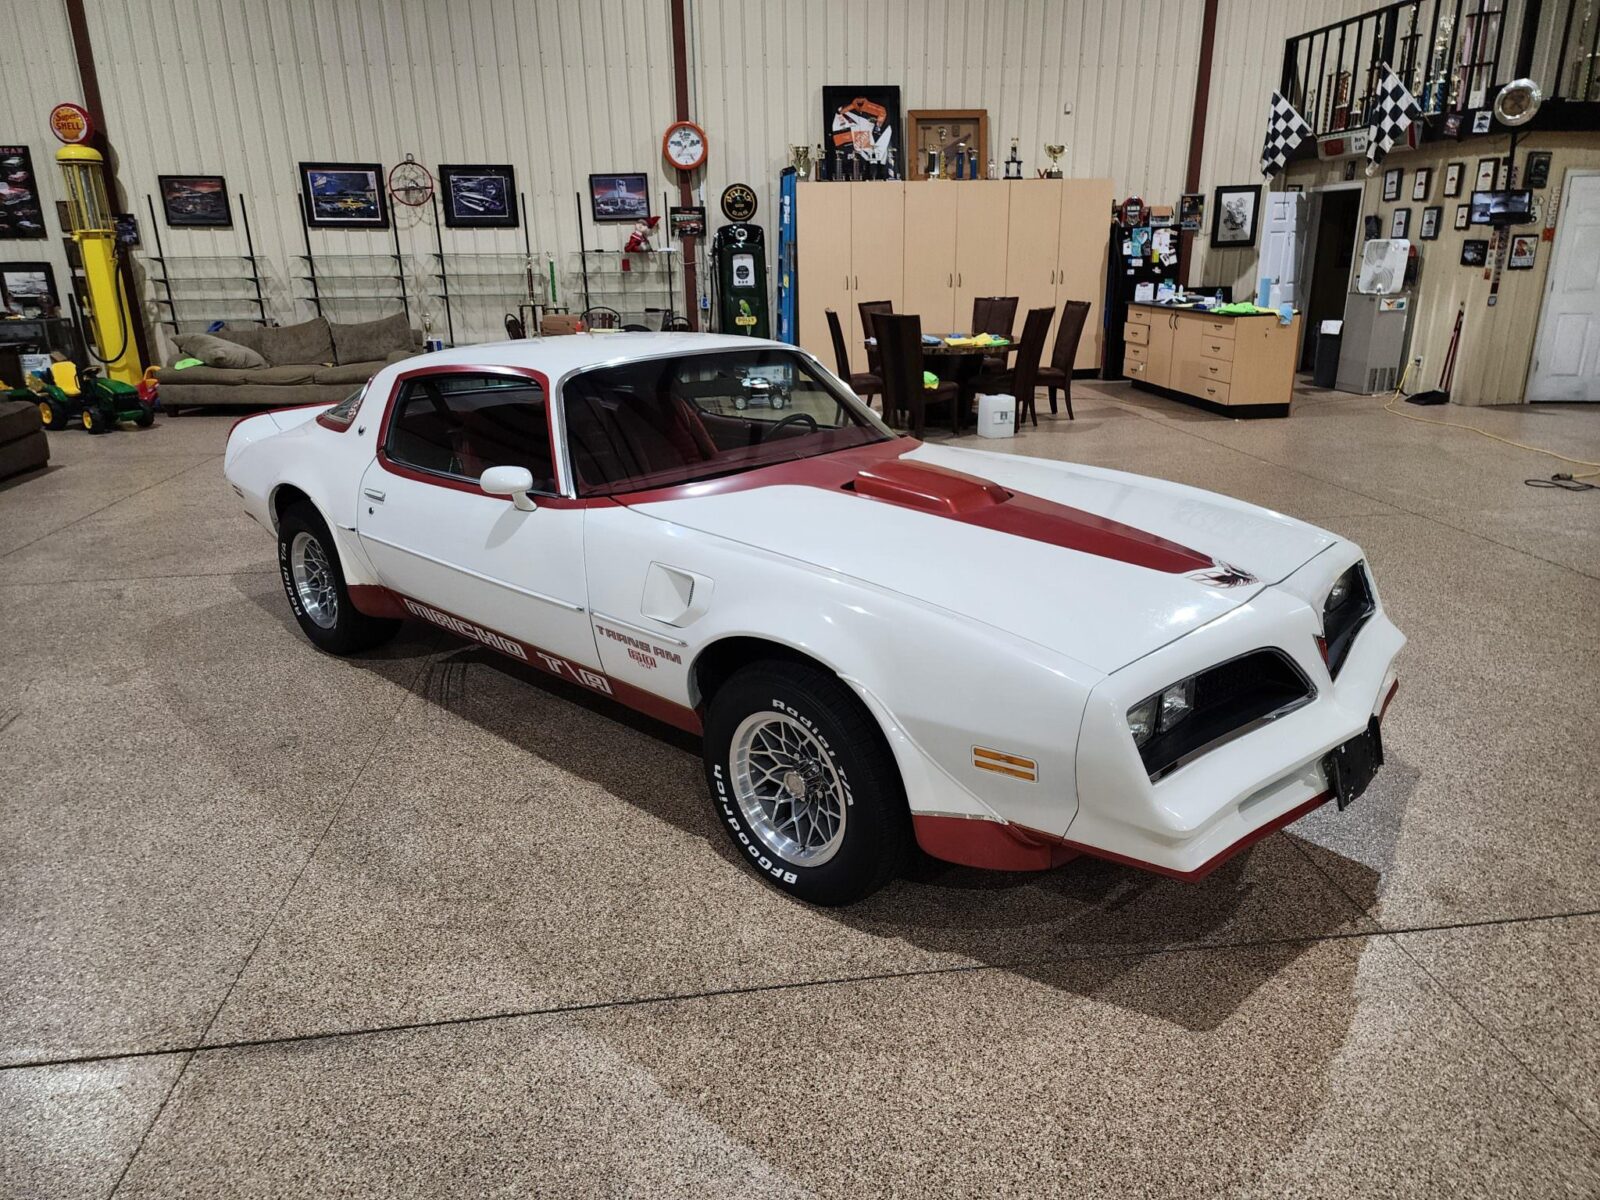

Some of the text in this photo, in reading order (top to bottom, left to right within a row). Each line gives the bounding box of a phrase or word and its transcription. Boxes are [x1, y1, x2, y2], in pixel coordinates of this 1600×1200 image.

[56, 122, 80, 130] SHELL
[726, 189, 752, 203] POLLY
[403, 598, 529, 661] MACHO
[595, 624, 682, 665] TRANS AM
[771, 698, 854, 806] Radial T/A
[714, 764, 799, 885] BFGoodrich
